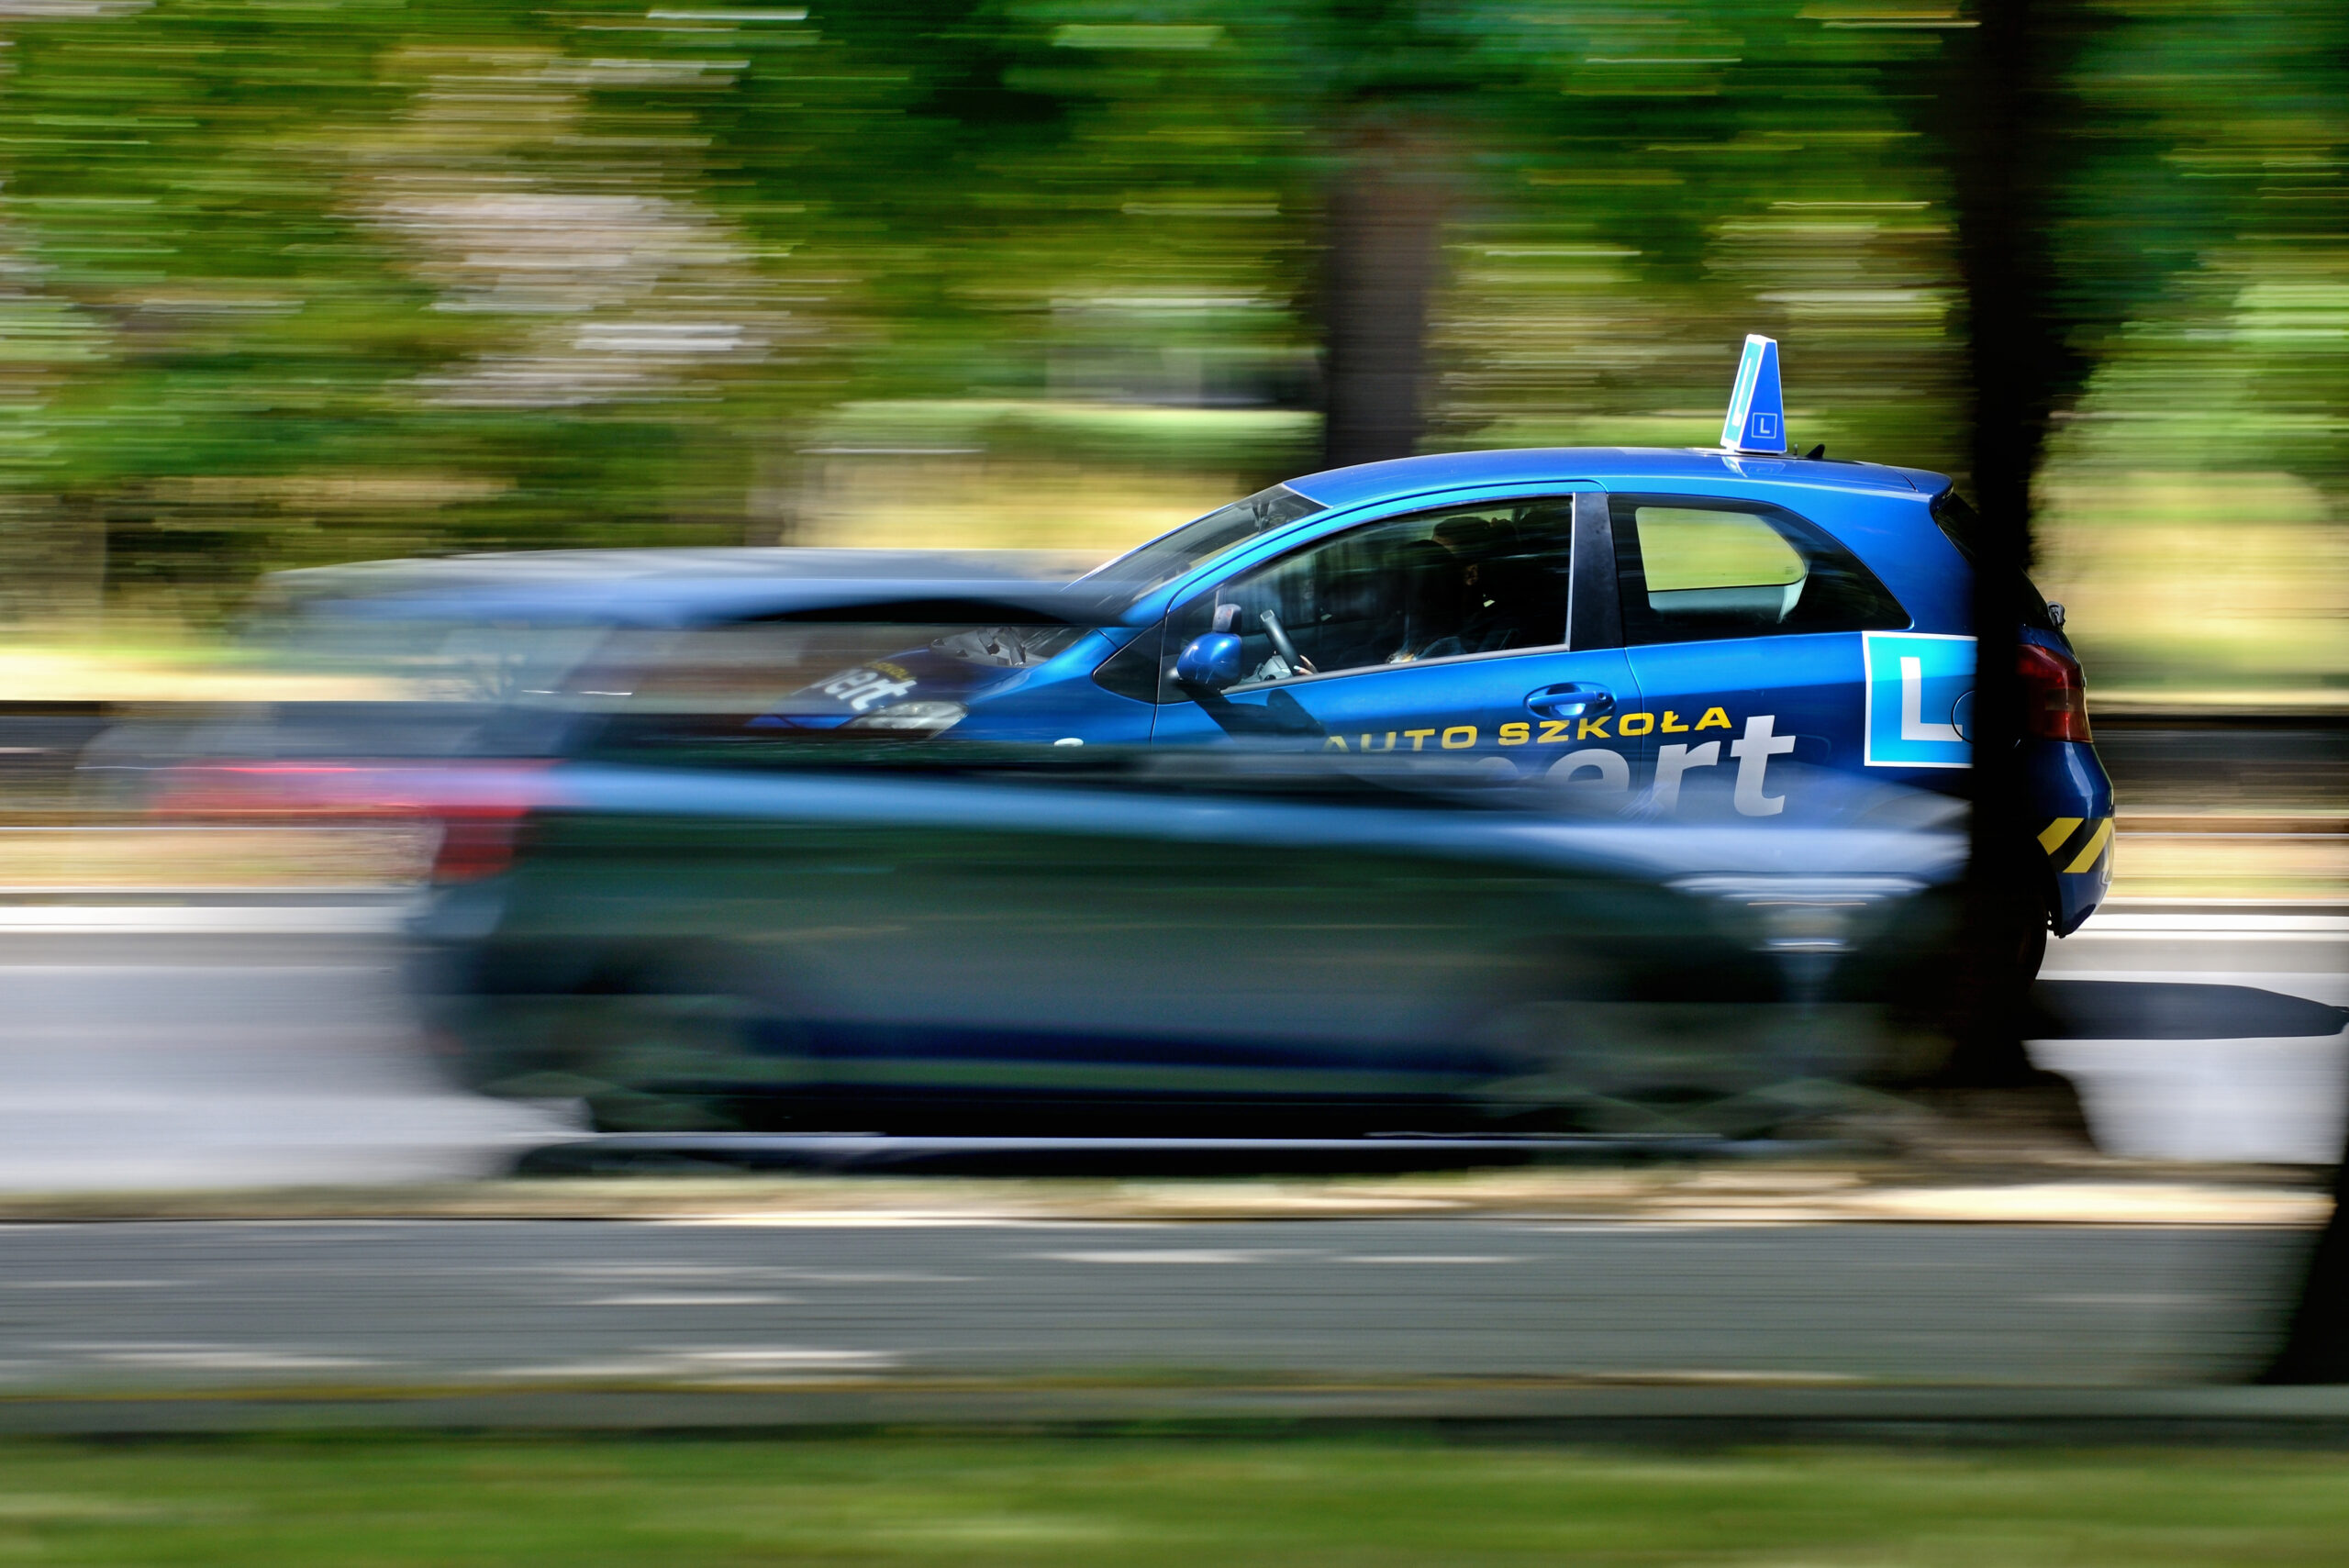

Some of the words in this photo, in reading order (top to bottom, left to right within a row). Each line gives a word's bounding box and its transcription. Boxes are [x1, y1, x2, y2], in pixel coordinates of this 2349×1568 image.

[1760, 417, 1771, 434] L
[1899, 656, 1964, 742] L
[1322, 725, 1478, 754] AUTO
[1497, 706, 1733, 746] SZKOŁA
